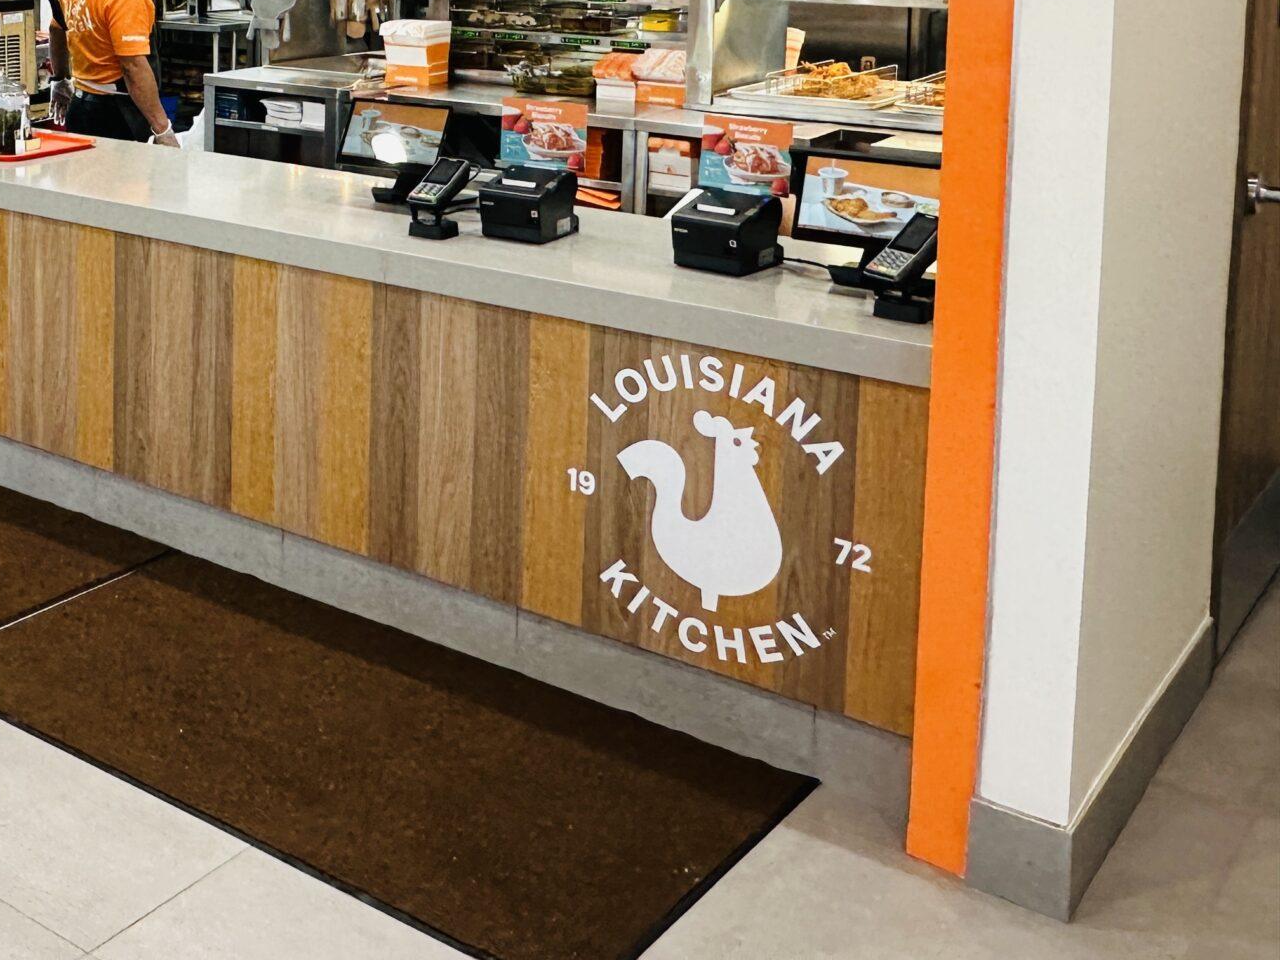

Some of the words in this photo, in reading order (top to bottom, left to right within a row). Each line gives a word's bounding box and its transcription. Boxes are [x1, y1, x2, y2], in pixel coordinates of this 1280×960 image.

[589, 354, 845, 476] LOUISIANA
[567, 467, 596, 496] 19
[833, 537, 872, 574] 72
[599, 559, 821, 665] KITCHEN
